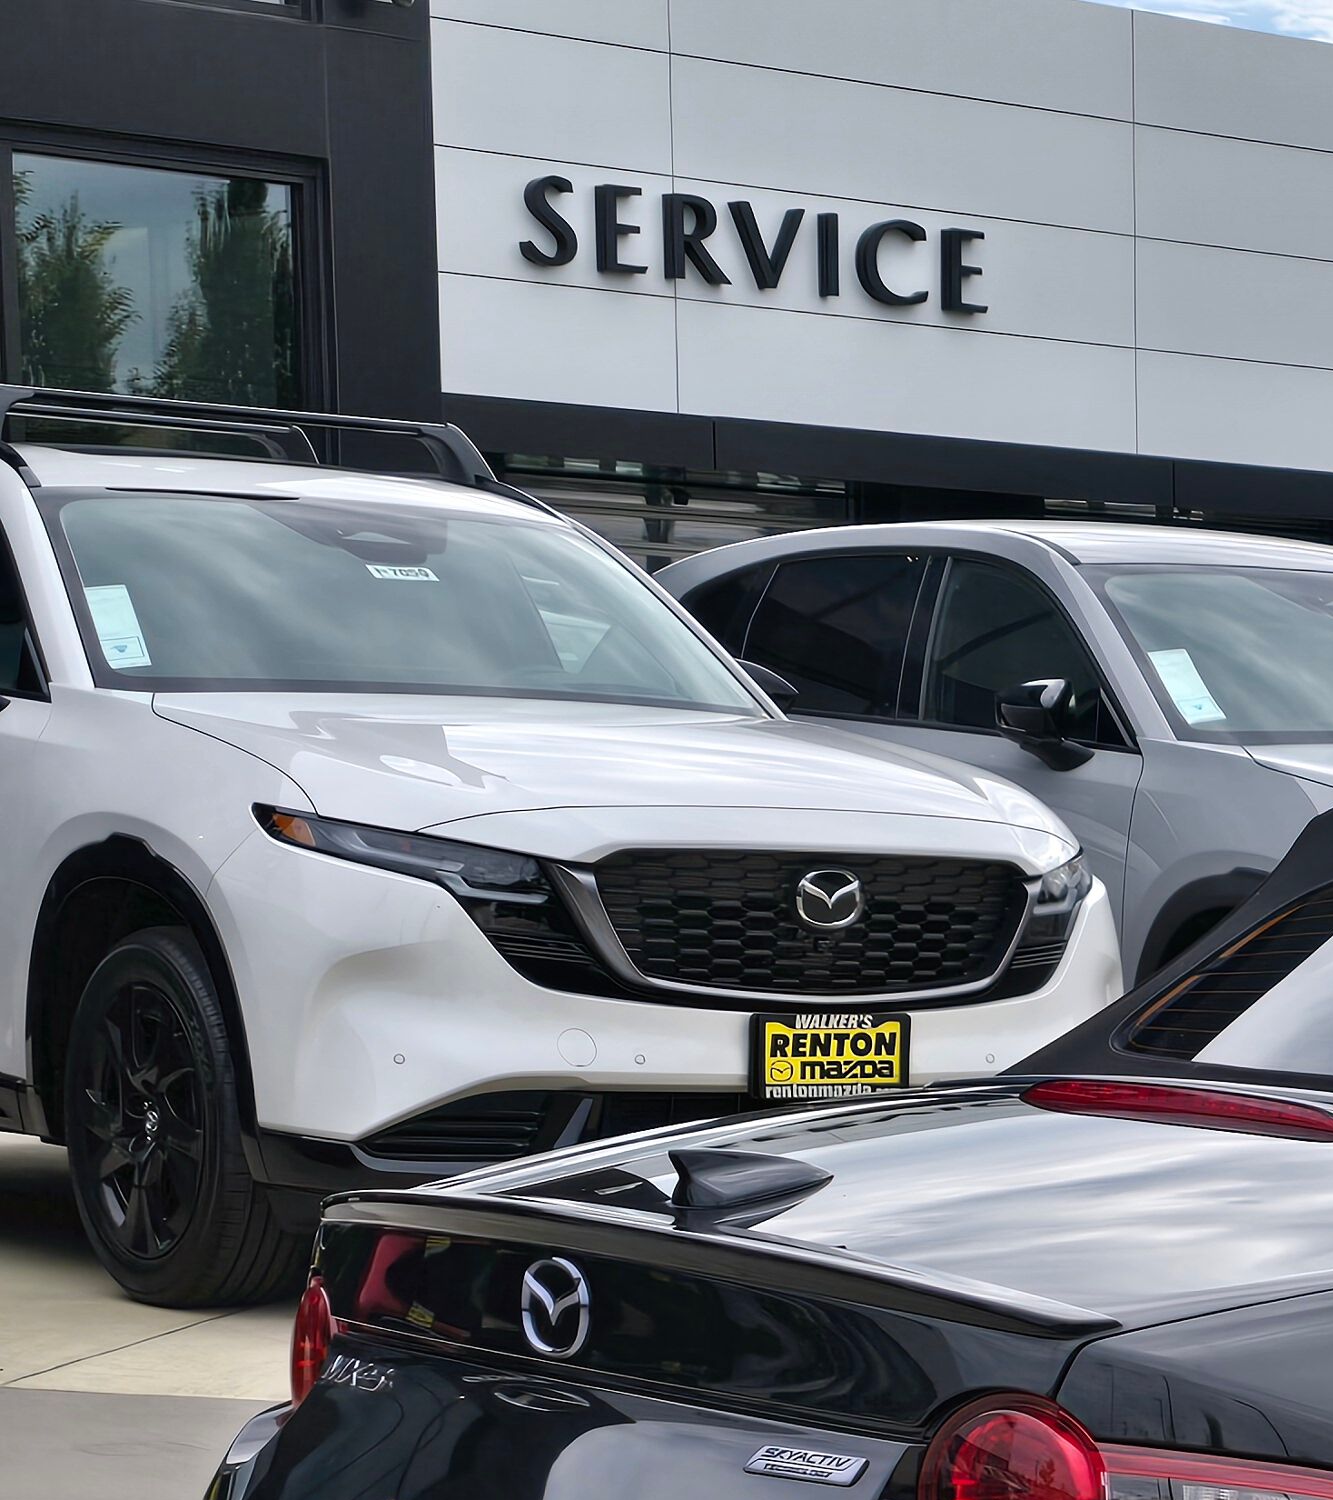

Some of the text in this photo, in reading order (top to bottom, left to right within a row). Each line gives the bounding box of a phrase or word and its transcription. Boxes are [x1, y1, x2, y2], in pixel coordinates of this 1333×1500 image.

[519, 174, 989, 315] SERVICE
[795, 1014, 873, 1029] WALKER'S
[770, 1032, 897, 1058] RENTON
[800, 1060, 895, 1080] mazda
[761, 1447, 852, 1468] SKYACTIV
